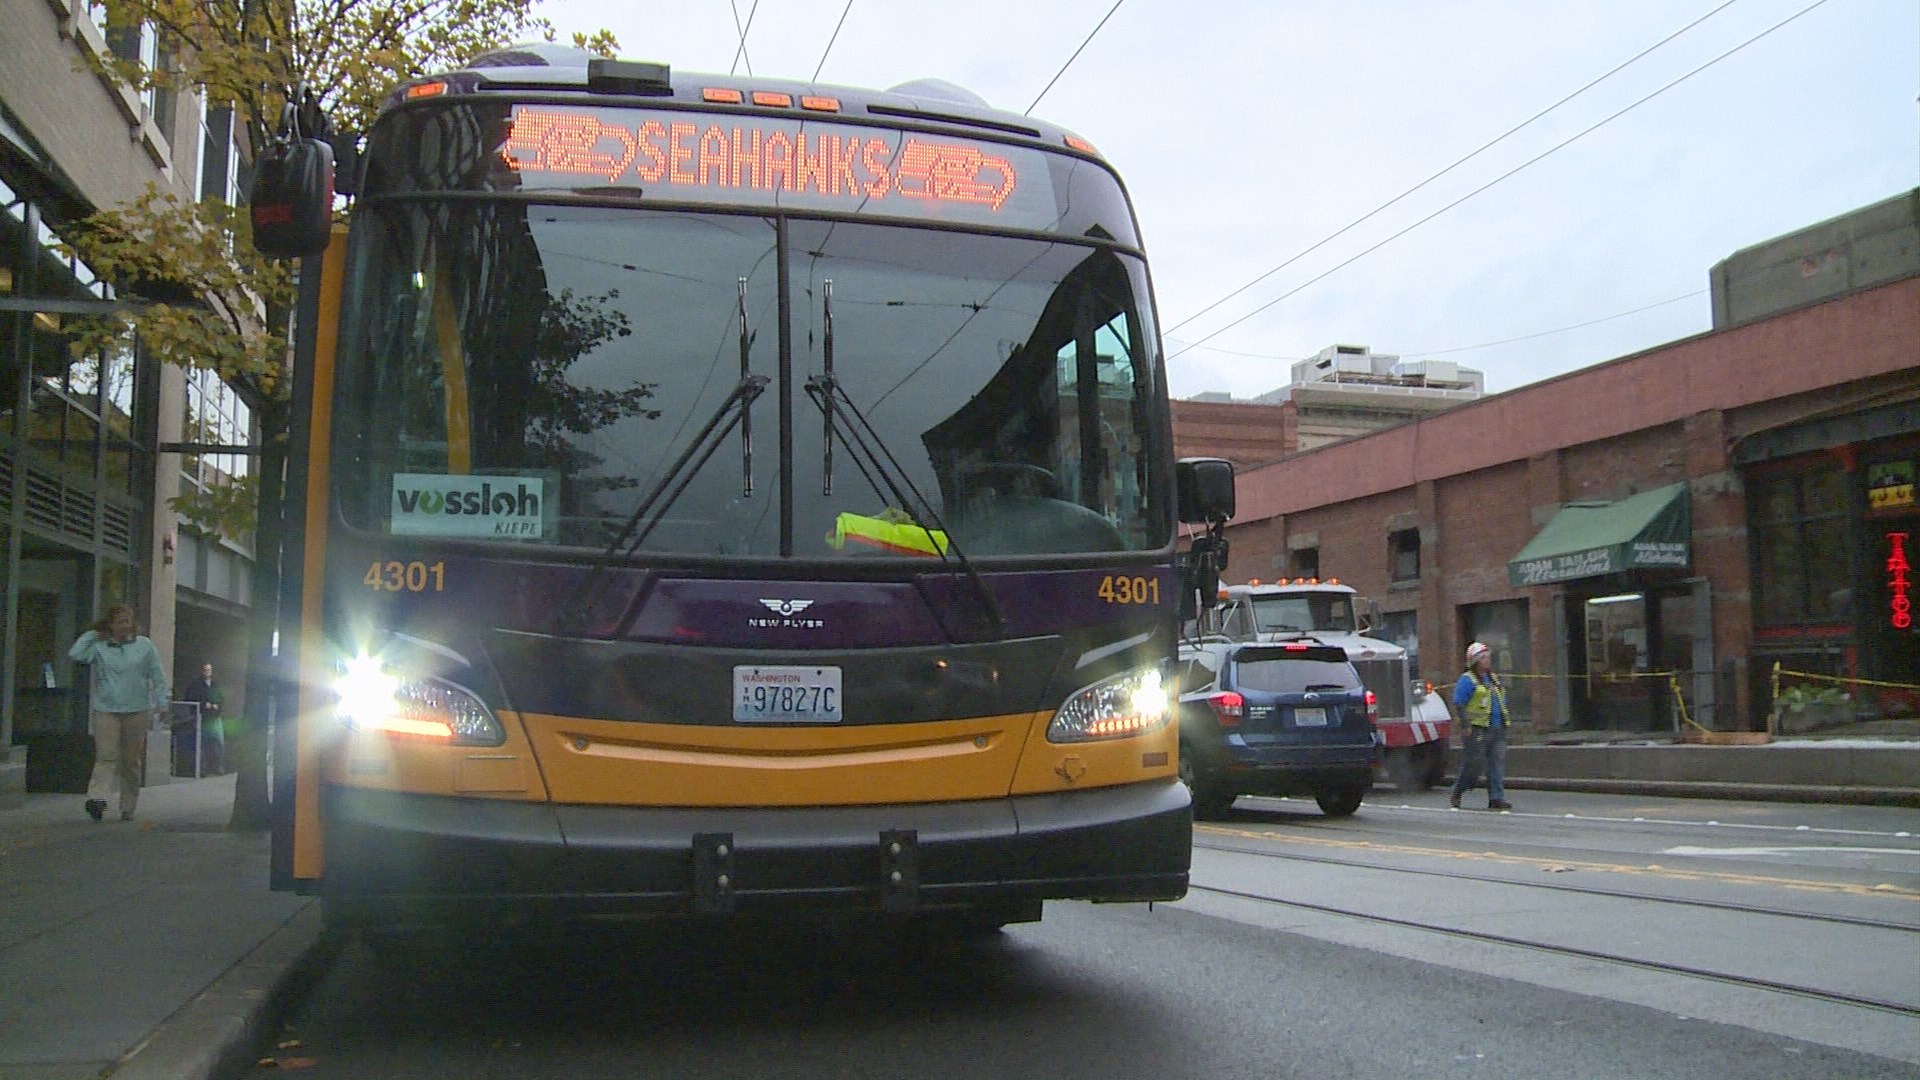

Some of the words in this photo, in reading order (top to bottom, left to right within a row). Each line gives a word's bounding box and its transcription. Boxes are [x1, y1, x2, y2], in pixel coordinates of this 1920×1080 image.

[637, 121, 893, 197] SEAHAWKS
[397, 483, 538, 516] vossloh
[494, 522, 537, 535] KIEPE
[364, 561, 445, 592] 4301
[1098, 575, 1160, 604] 4301
[748, 618, 779, 627] NEW
[783, 619, 824, 627] FLYER
[742, 674, 801, 683] WASHINGTON
[754, 686, 835, 712] 97827C
